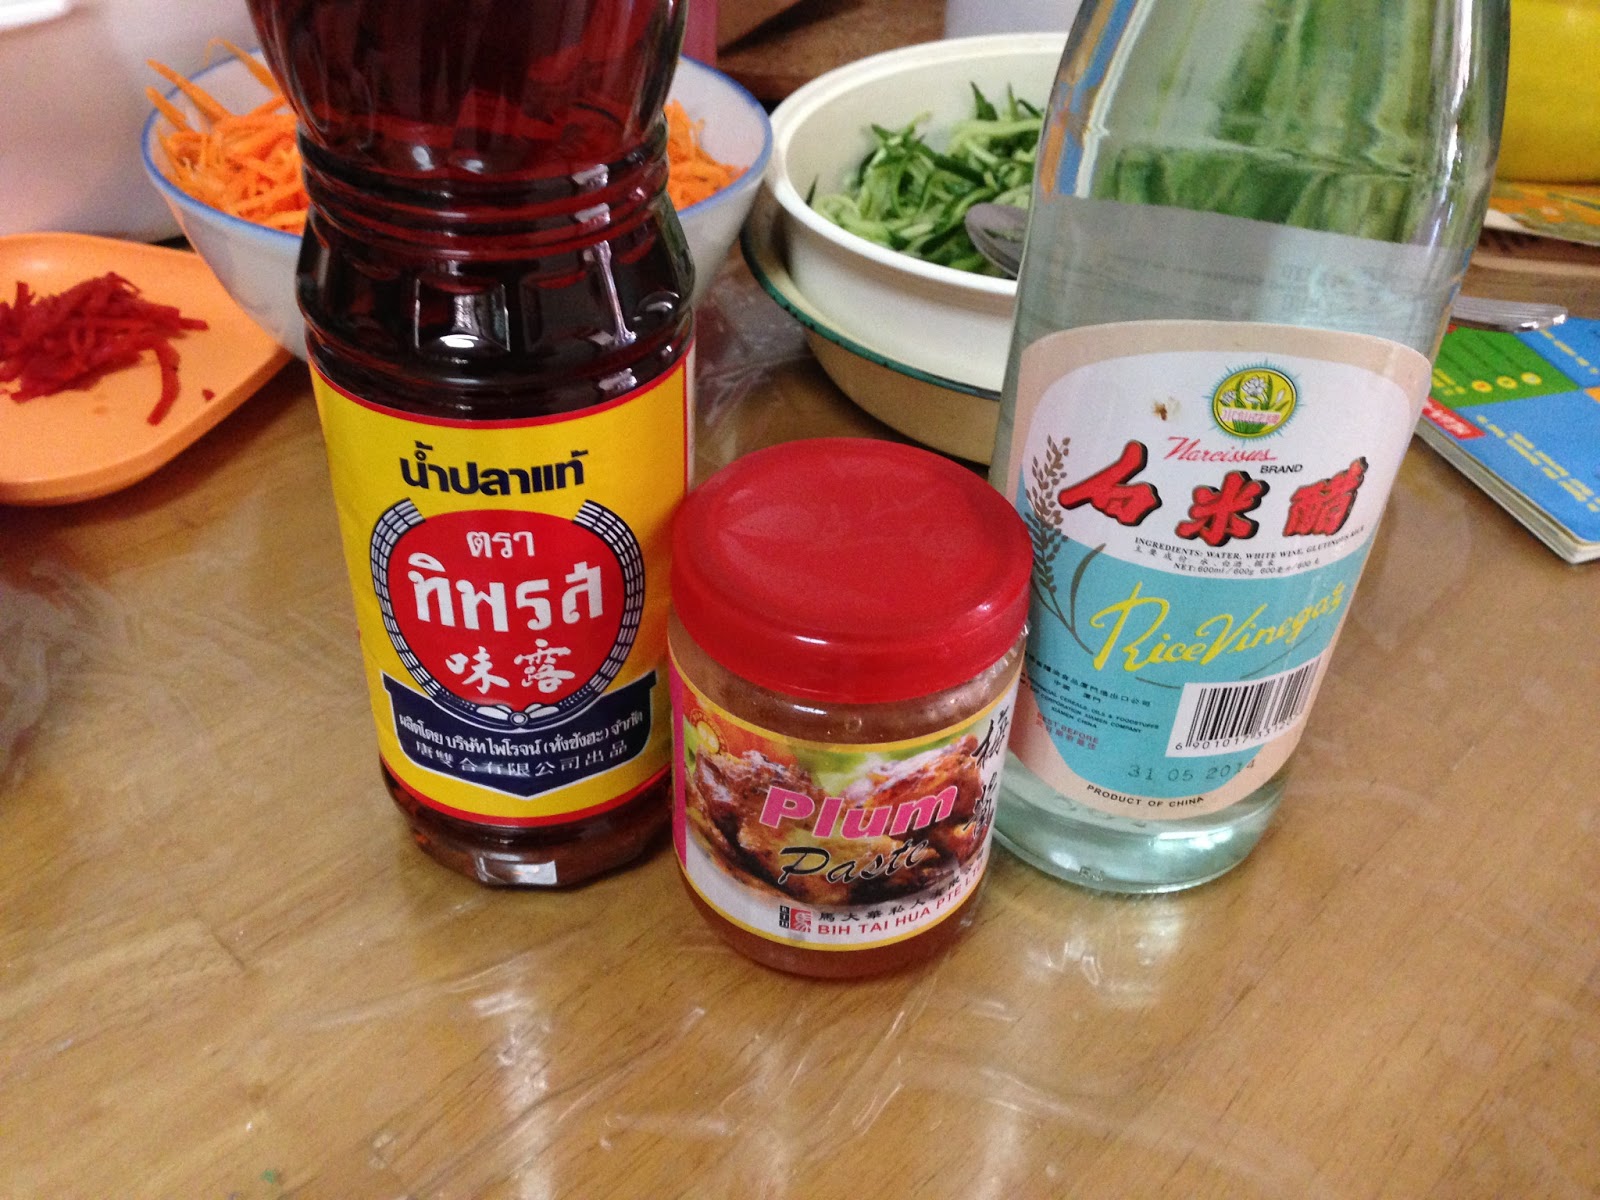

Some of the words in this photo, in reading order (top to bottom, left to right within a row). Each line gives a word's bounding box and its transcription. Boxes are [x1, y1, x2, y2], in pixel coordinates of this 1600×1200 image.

[400, 441, 589, 495] น้ำปลาแท้
[1163, 436, 1277, 462] Narcissus
[1260, 463, 1304, 475] BRAND
[466, 530, 535, 559] ตรา
[1135, 537, 1203, 558] INGREDIENTS:
[1207, 551, 1242, 560] WATER,
[1245, 552, 1277, 560] WHITE
[408, 552, 604, 632] ทิพรส
[1090, 581, 1207, 672] Rice
[1195, 581, 1346, 666] Vinegar
[445, 639, 576, 694] 味露
[1175, 741, 1183, 750] 6
[1192, 735, 1249, 750] 901017
[1128, 764, 1153, 781] 31
[1167, 768, 1194, 782] 05
[758, 785, 958, 840] Plum
[1086, 784, 1142, 806] PRODUCT
[1169, 796, 1205, 808] CHINA
[777, 838, 930, 886] Paste
[817, 924, 851, 935] BIH
[858, 919, 889, 934] TAI
[895, 907, 931, 927] HUA
[936, 883, 962, 910] PTE
